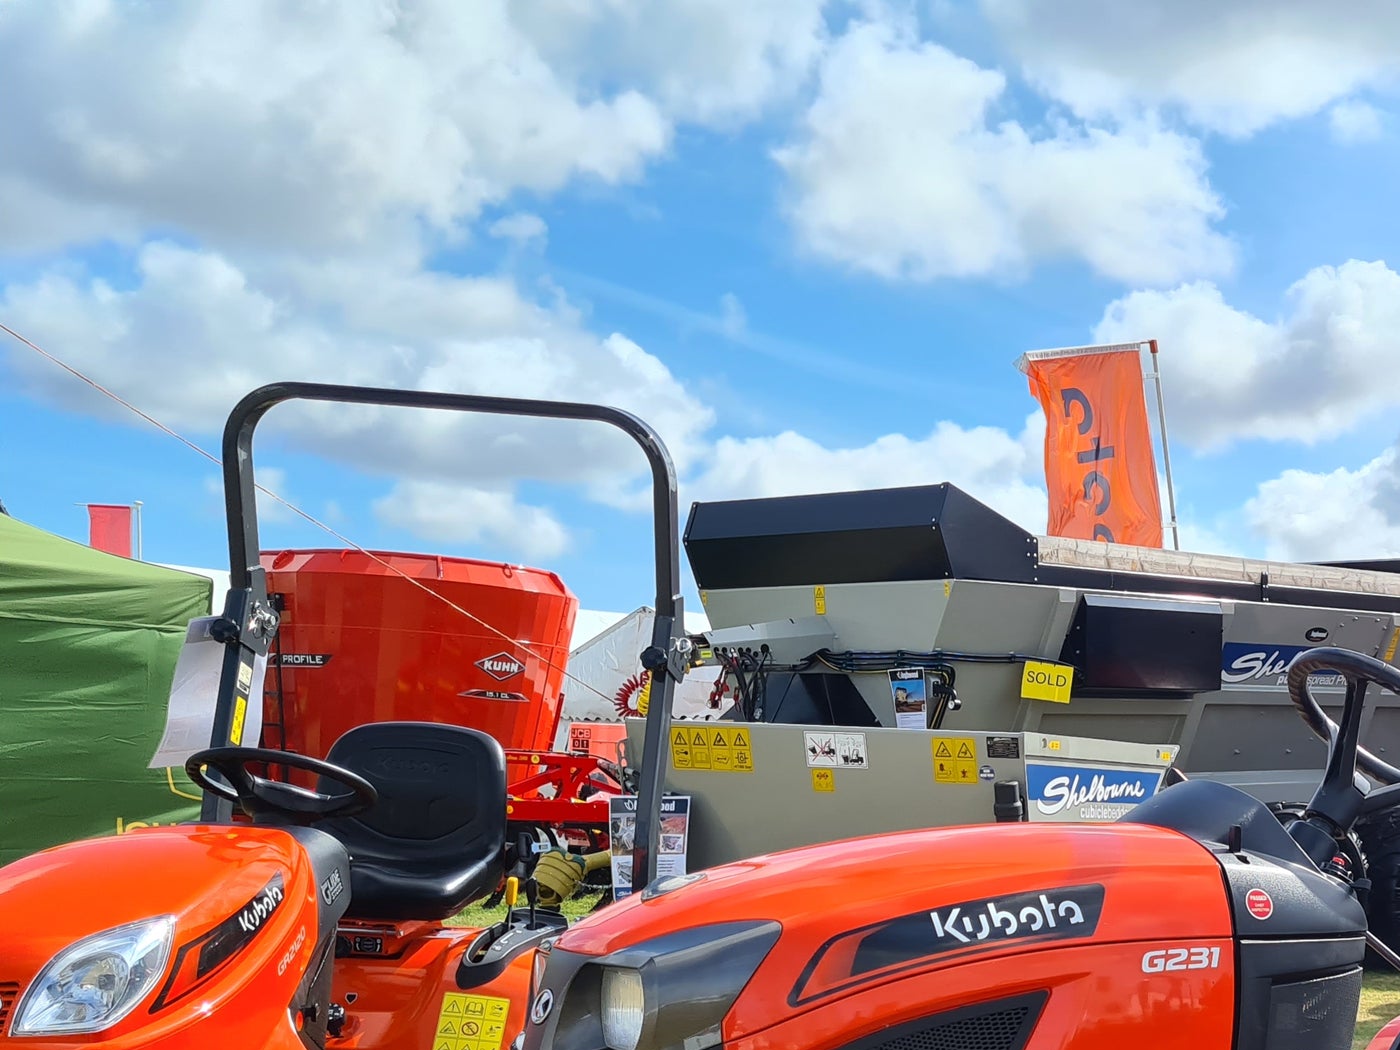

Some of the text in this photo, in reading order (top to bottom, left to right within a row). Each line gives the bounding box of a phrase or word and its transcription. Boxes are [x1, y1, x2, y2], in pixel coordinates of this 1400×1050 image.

[282, 654, 323, 665] PROFILE
[484, 660, 519, 673] KUHN
[1026, 670, 1067, 687] SOLD
[571, 728, 591, 738] JCB
[1037, 774, 1145, 815] Shelbourne
[238, 886, 284, 931] Kubota
[930, 895, 1085, 943] Kubota
[277, 925, 306, 976] GR2120
[1142, 947, 1221, 973] G231
